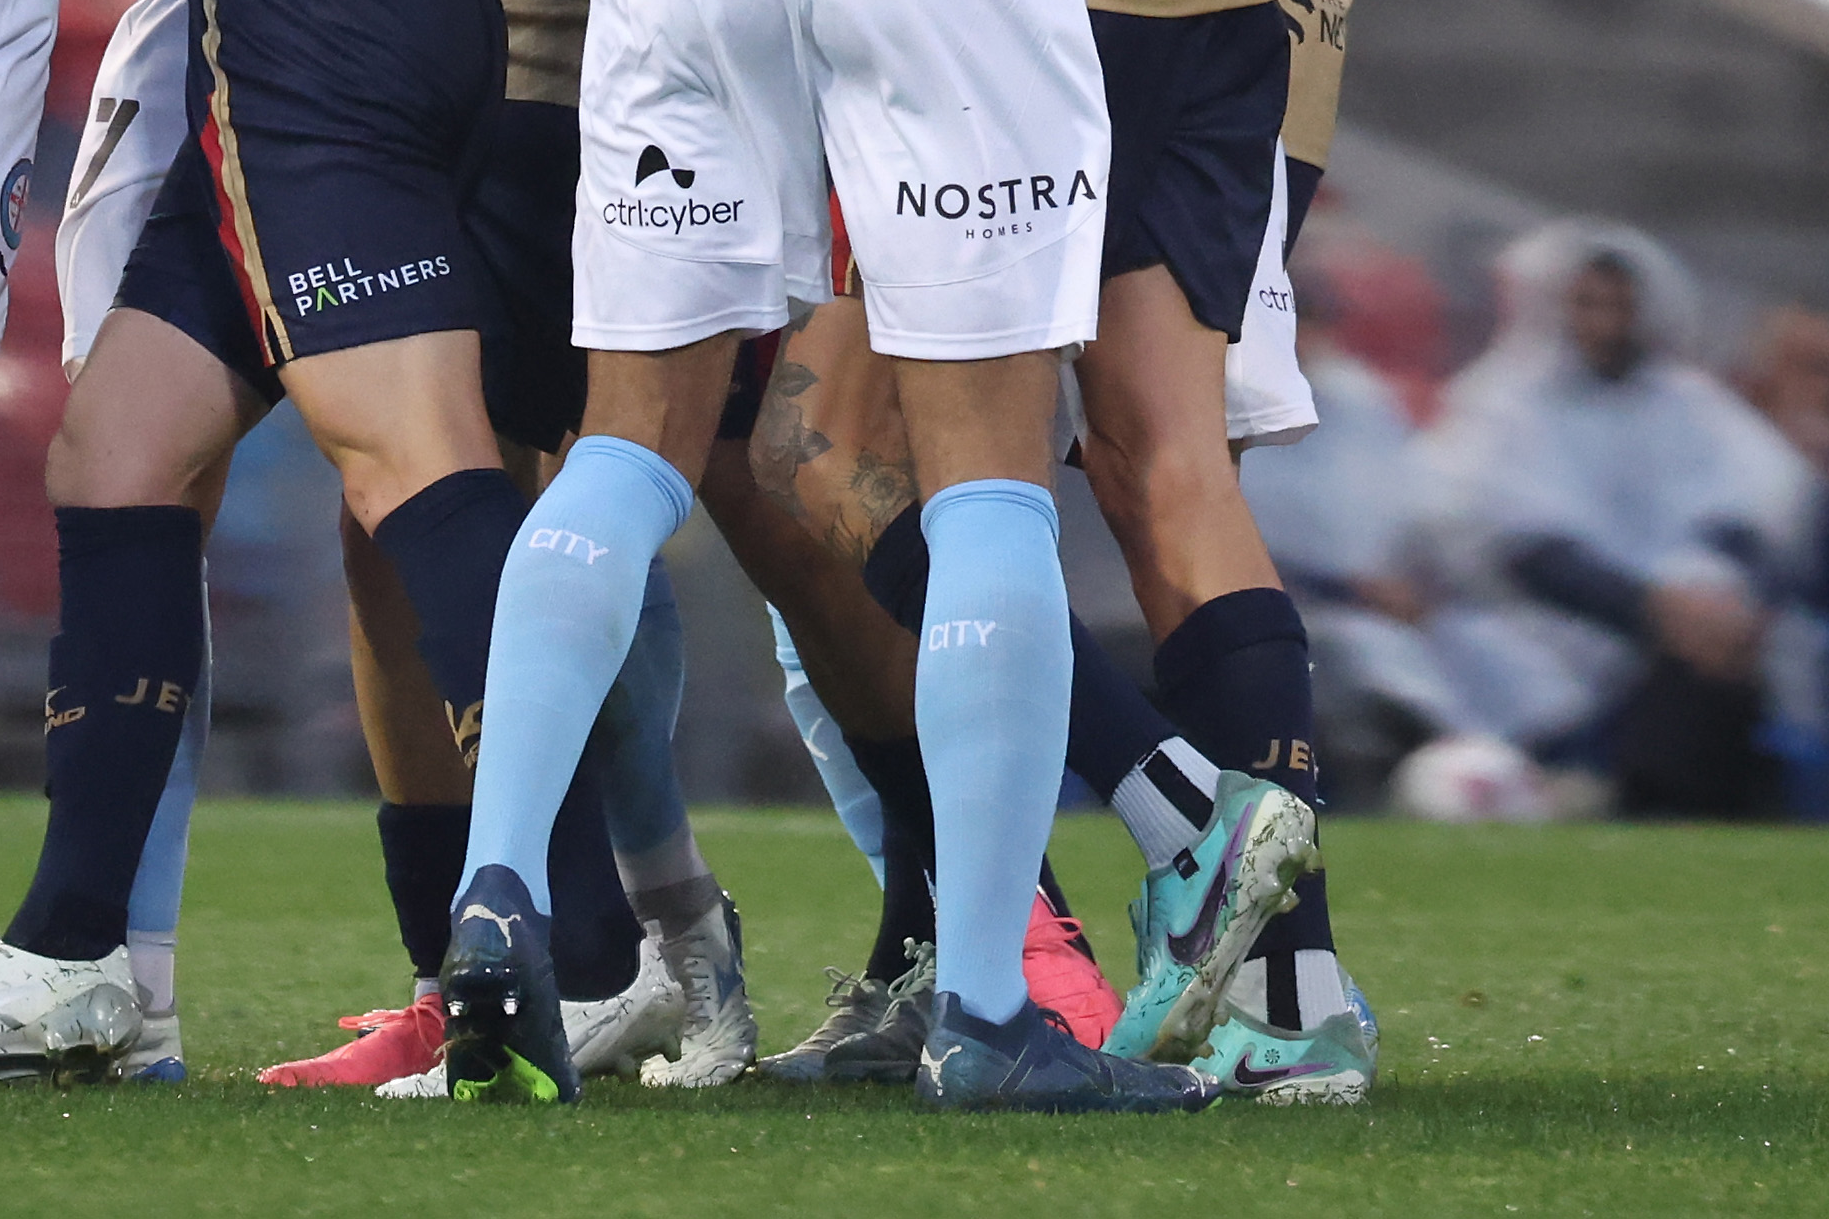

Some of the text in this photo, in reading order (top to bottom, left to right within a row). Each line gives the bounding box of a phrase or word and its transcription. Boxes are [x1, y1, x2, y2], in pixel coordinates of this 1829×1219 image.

[896, 170, 1098, 220] NOSTRA
[603, 198, 744, 235] ctrl:cyber
[966, 222, 1033, 240] HOMES
[288, 257, 362, 295] BELL
[295, 255, 451, 317] PARTNERS
[528, 527, 610, 566] CITY
[928, 620, 997, 652] CITY
